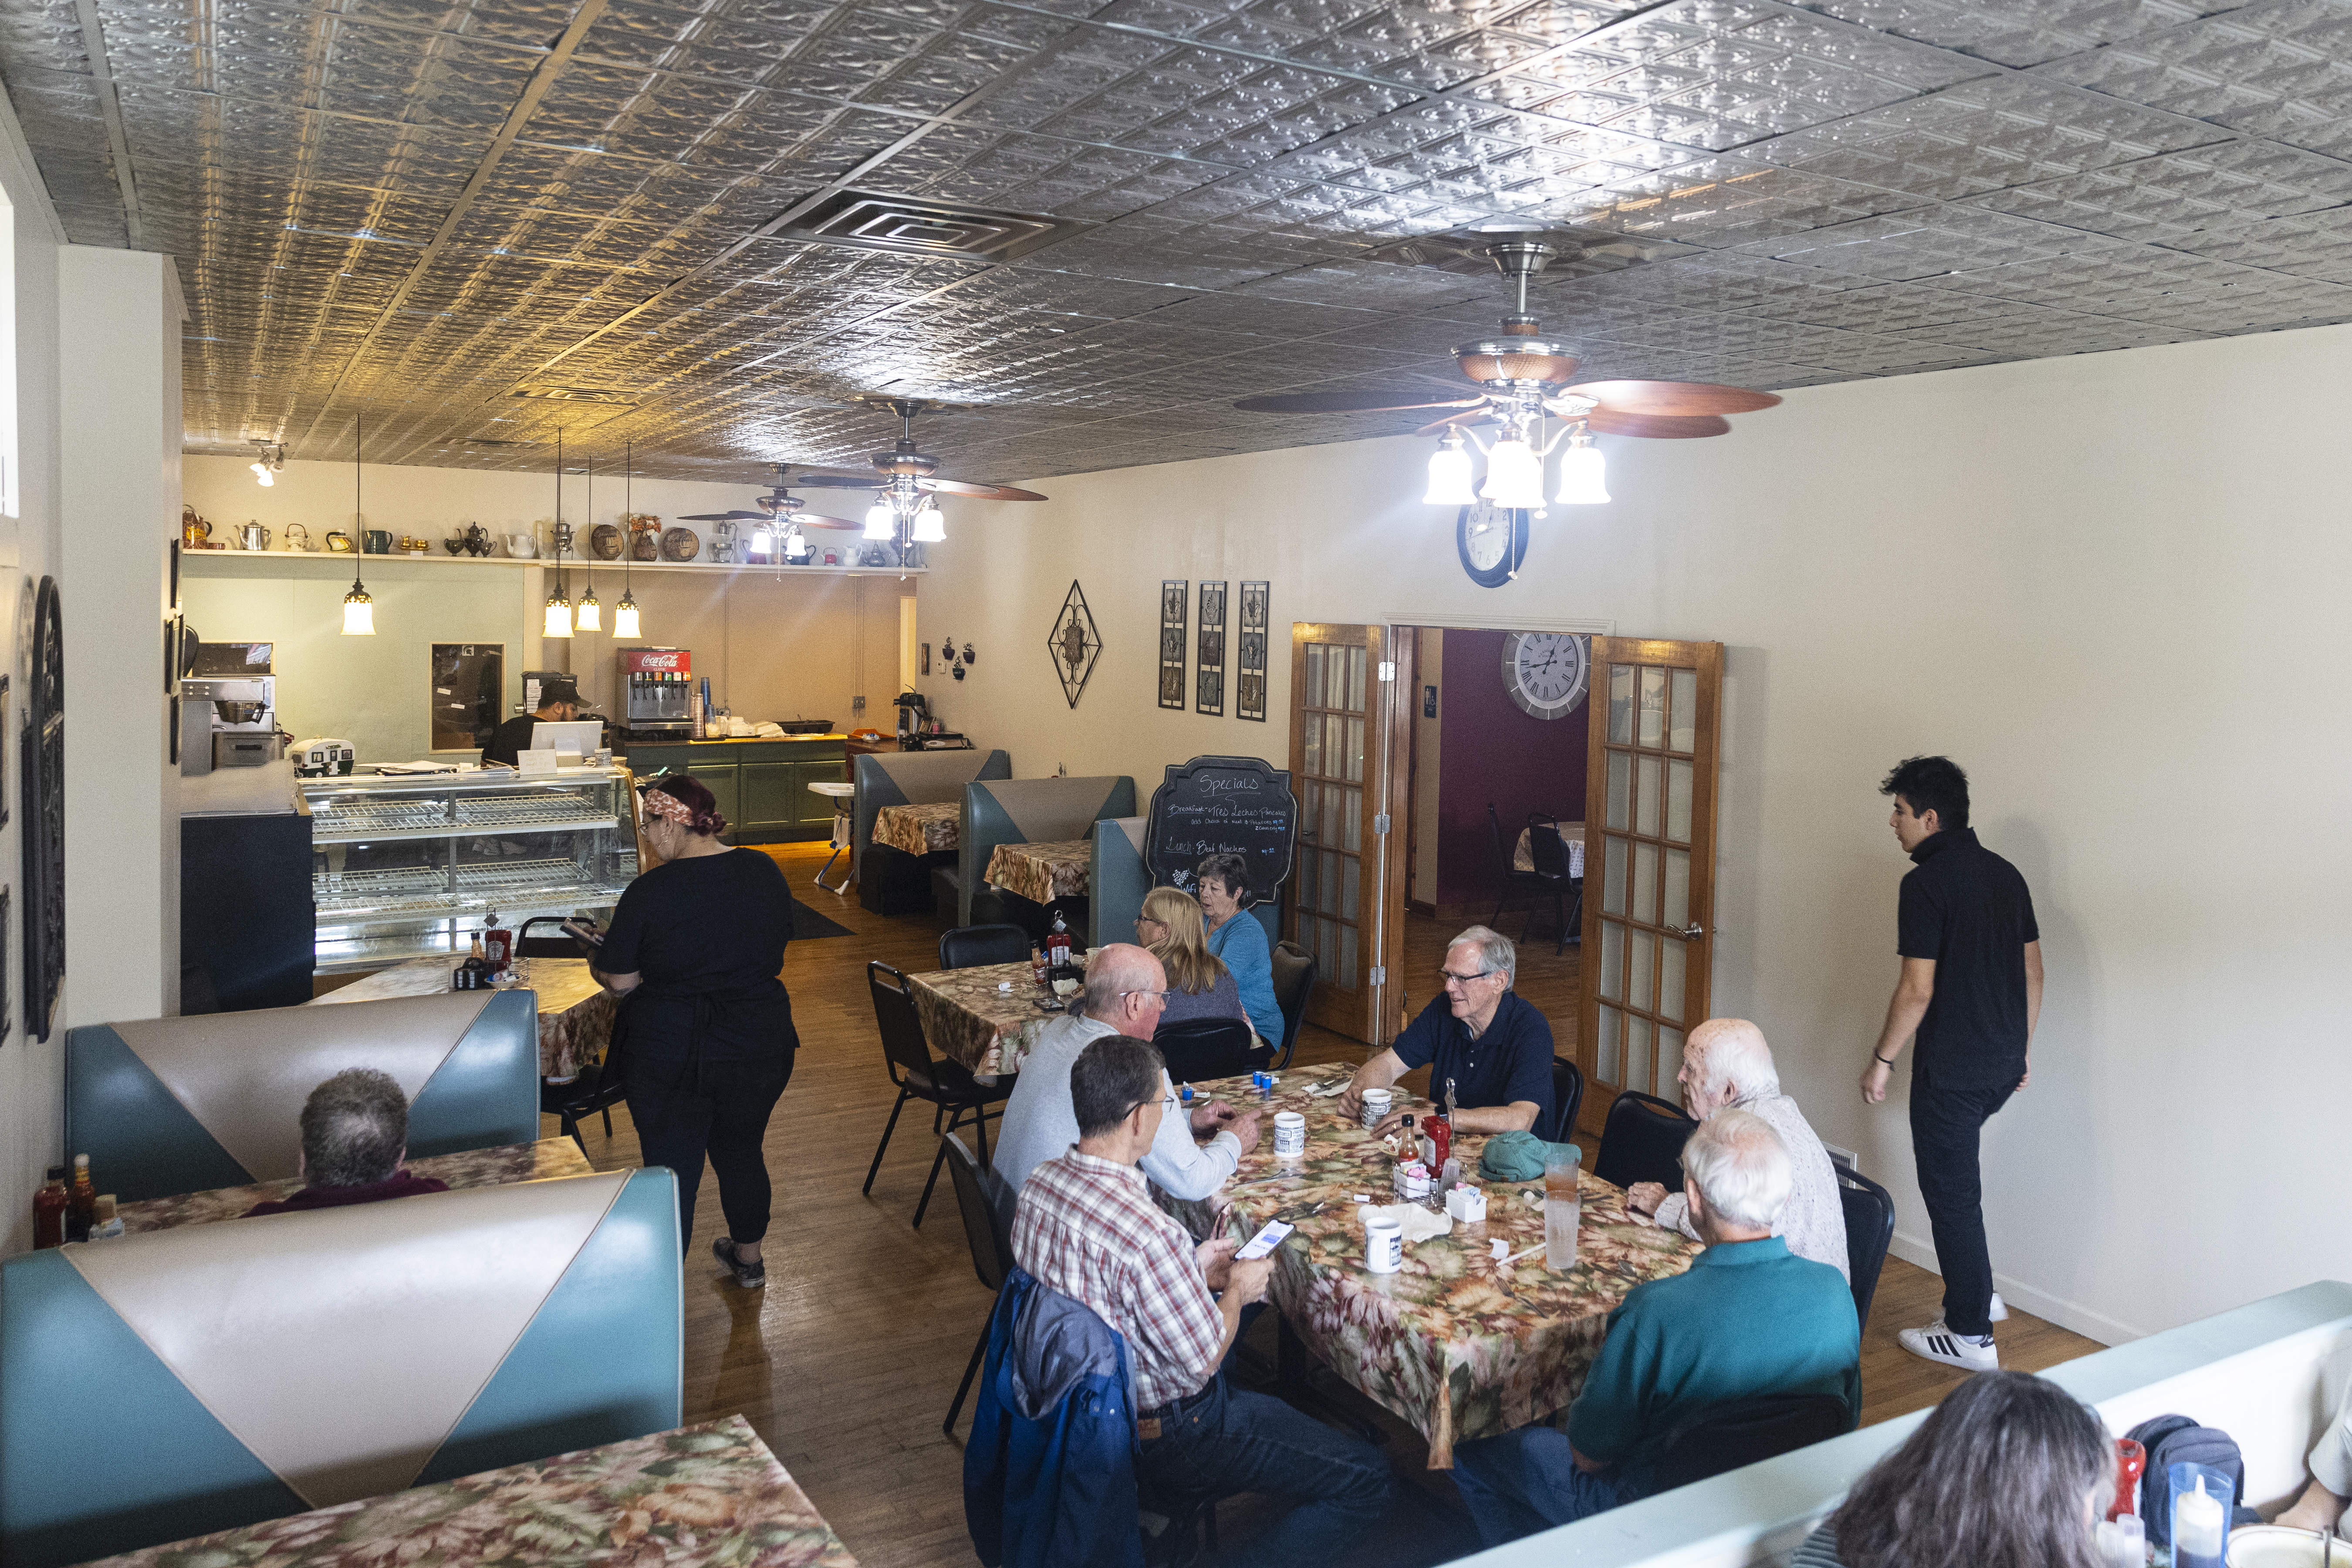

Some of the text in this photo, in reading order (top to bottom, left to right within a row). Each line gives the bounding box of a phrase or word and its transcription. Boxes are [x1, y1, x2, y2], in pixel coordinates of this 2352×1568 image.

[1479, 501, 1483, 512] 11
[1470, 512, 1479, 523] 10
[1502, 510, 1507, 521] 2
[1468, 527, 1473, 538] 9
[1504, 525, 1509, 536] 3
[1471, 541, 1475, 552] 8
[1502, 539, 1506, 550] 4
[1477, 551, 1482, 561] 7
[1486, 555, 1490, 565] 6
[1495, 551, 1500, 561] 5
[641, 655, 679, 667] Coca-Cola
[1200, 775, 1258, 796] Specials
[1208, 804, 1228, 817] Tres
[1231, 804, 1258, 816] Leches
[1259, 807, 1286, 819] Pancakes
[1196, 840, 1215, 855] Beef
[1220, 842, 1247, 853] Nachos
[1181, 883, 1196, 893] Wifi
